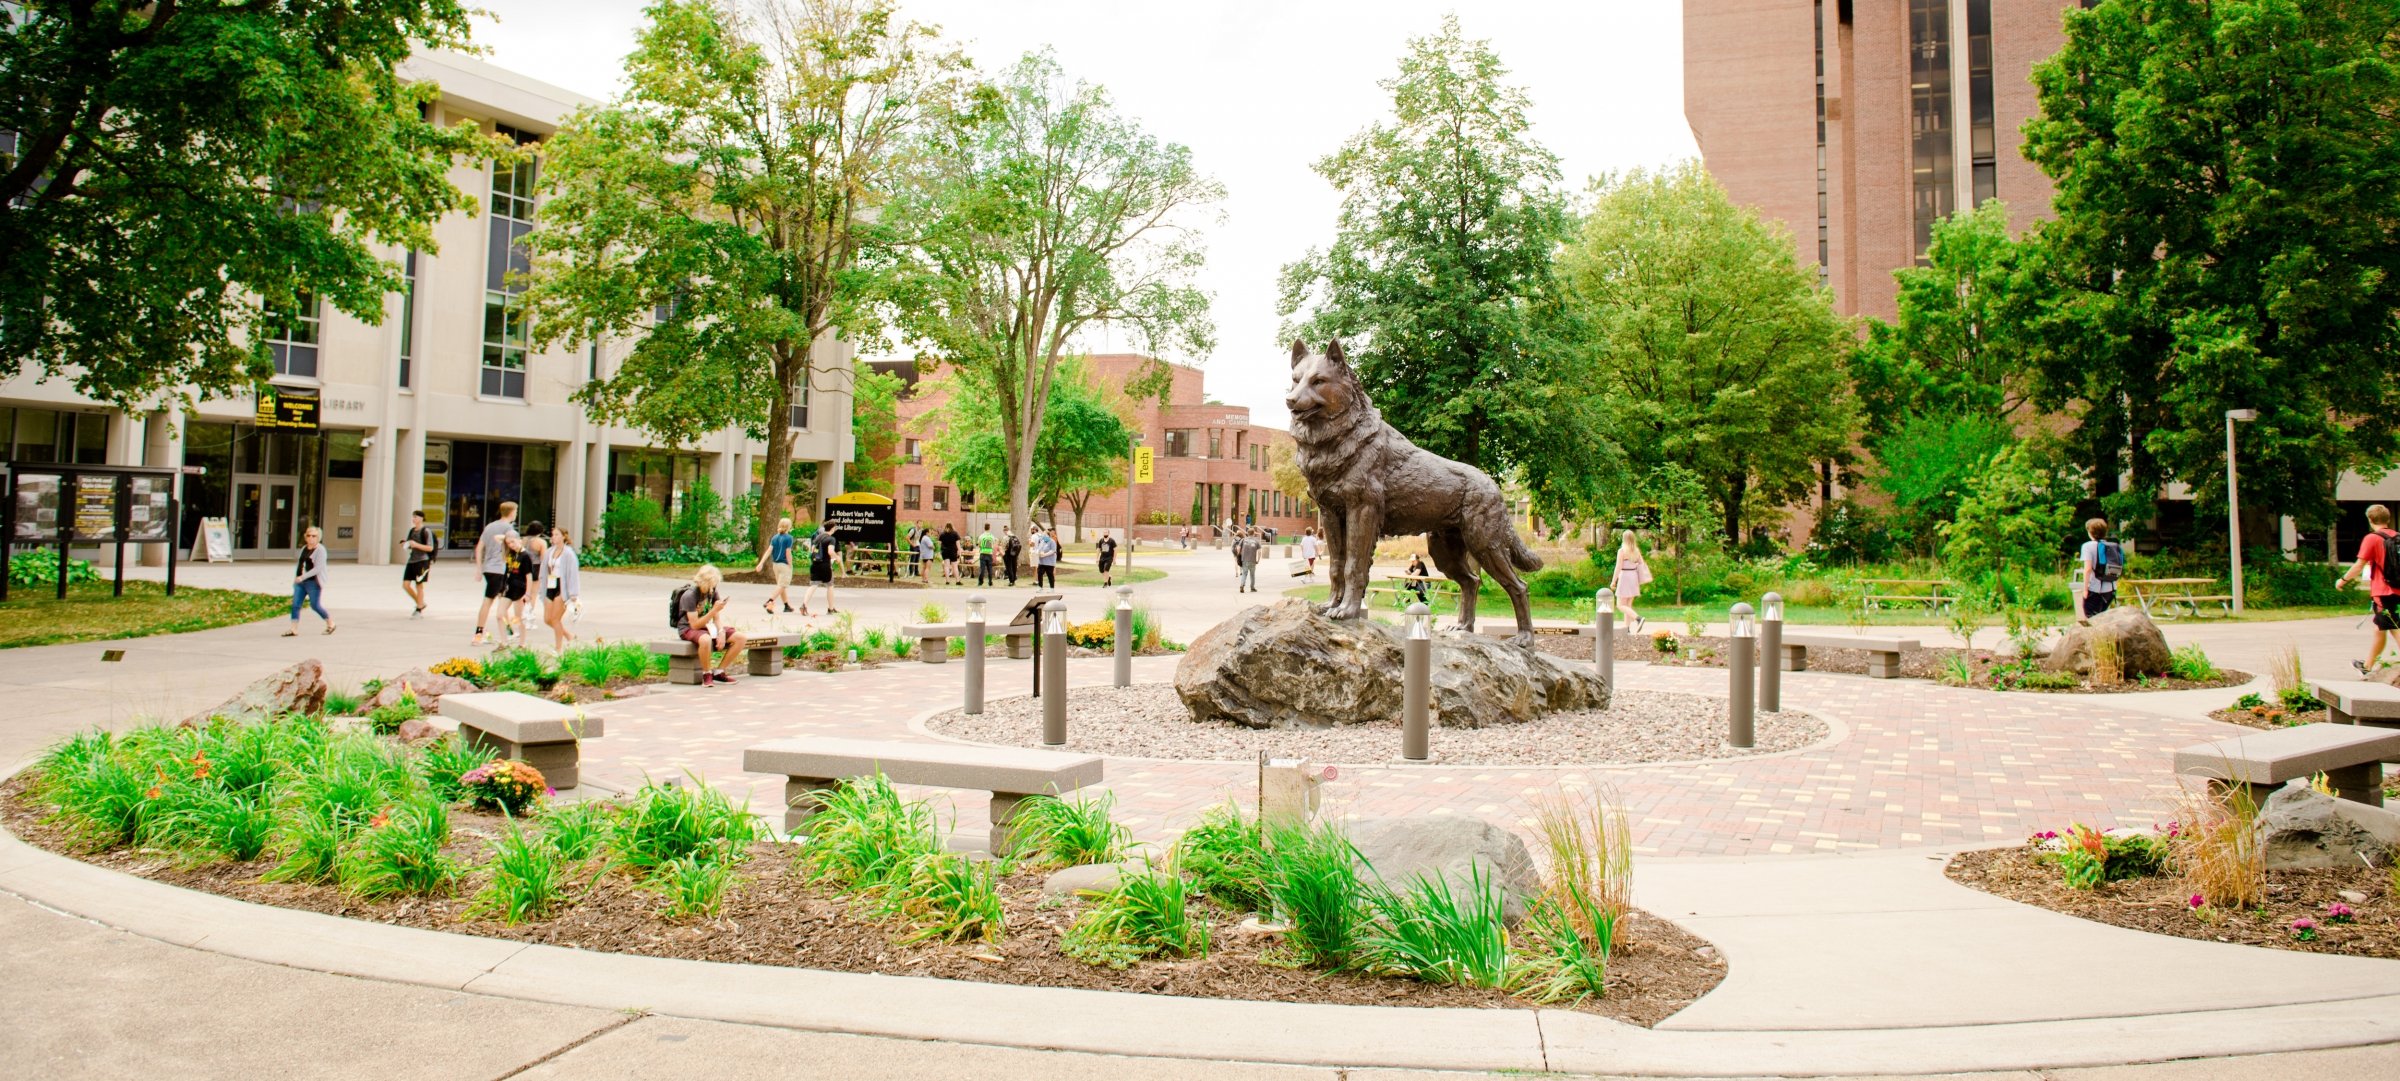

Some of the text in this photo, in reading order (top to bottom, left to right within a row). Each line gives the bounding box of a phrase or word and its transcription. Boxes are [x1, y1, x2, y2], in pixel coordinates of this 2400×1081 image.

[323, 398, 365, 411] LIBRARY
[1140, 452, 1149, 478] Tech
[844, 525, 862, 533] Library
